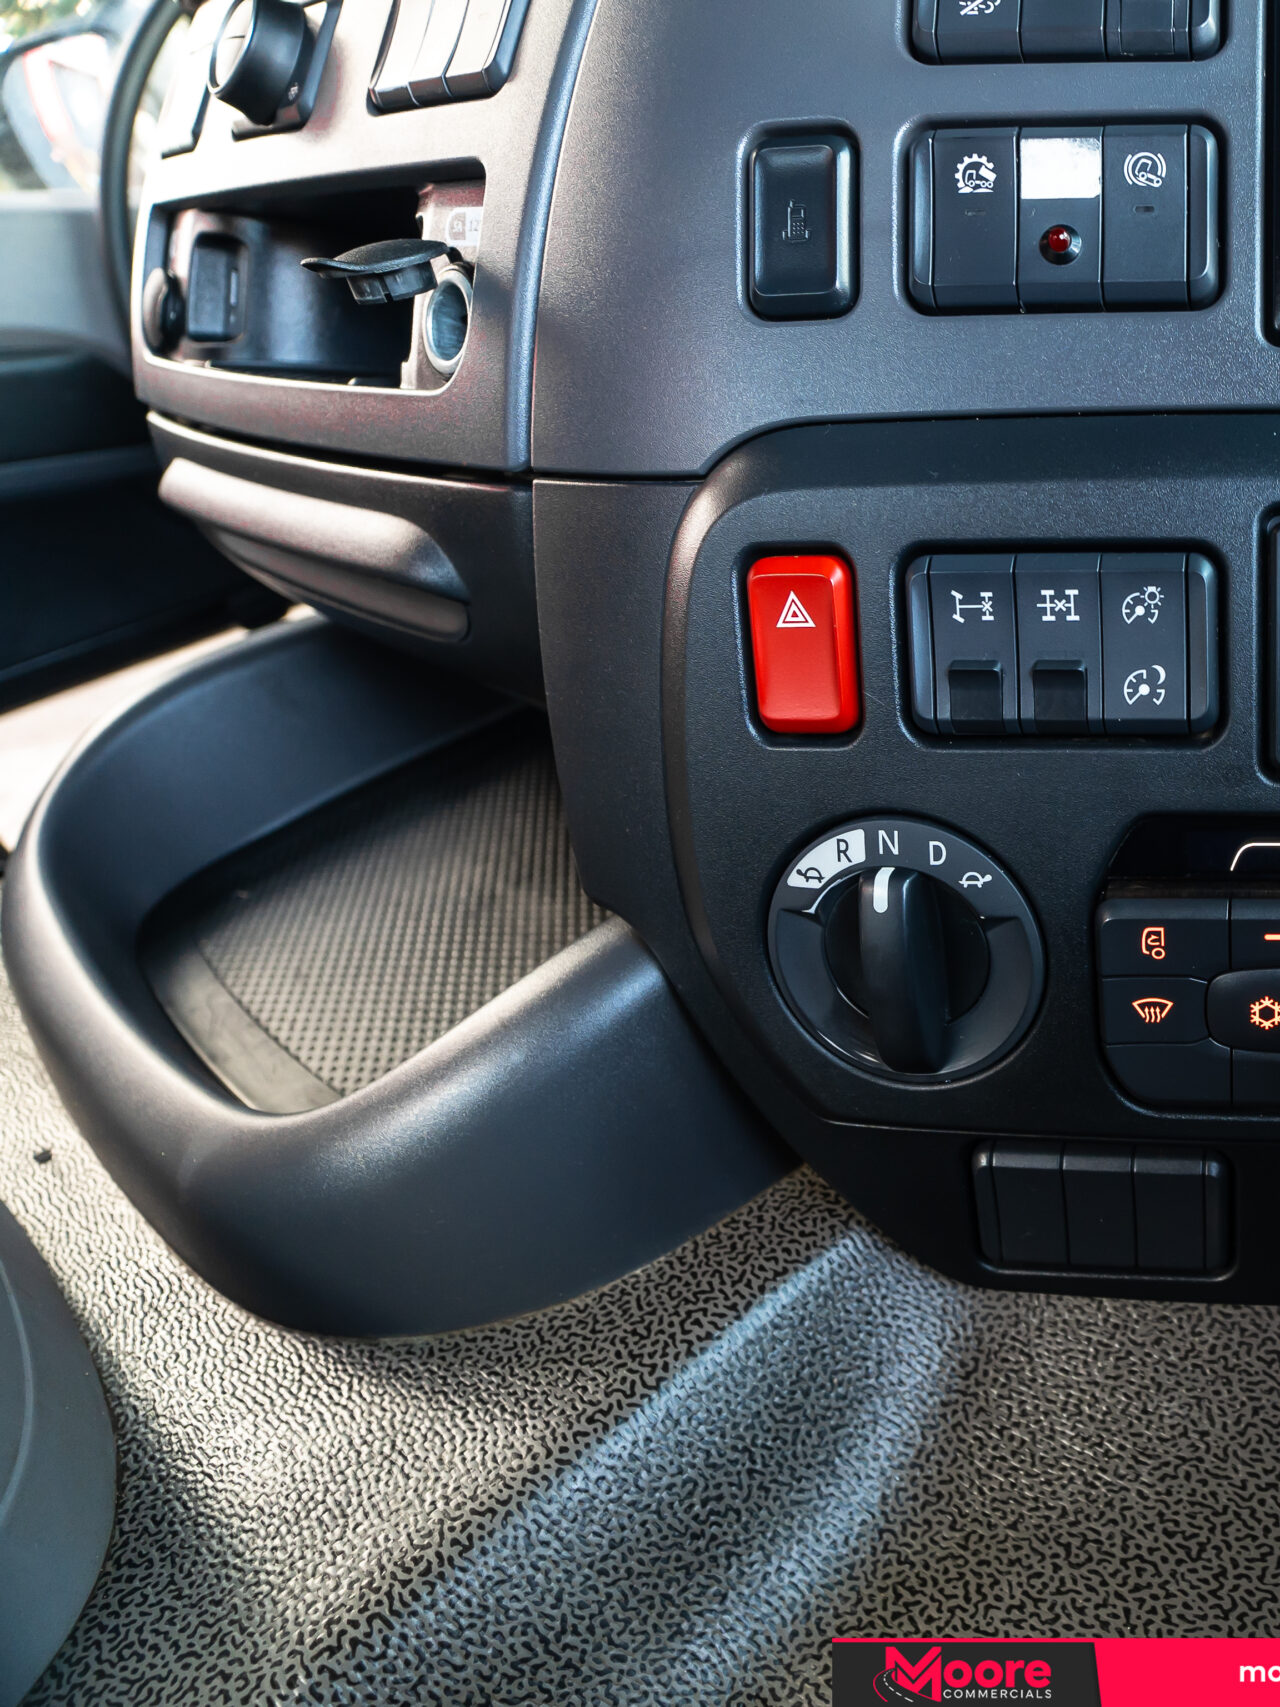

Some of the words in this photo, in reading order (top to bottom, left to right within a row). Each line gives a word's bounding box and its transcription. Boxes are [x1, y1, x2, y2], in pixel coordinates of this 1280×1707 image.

[836, 838, 853, 863] R
[878, 829, 899, 855] N
[928, 840, 948, 866] D
